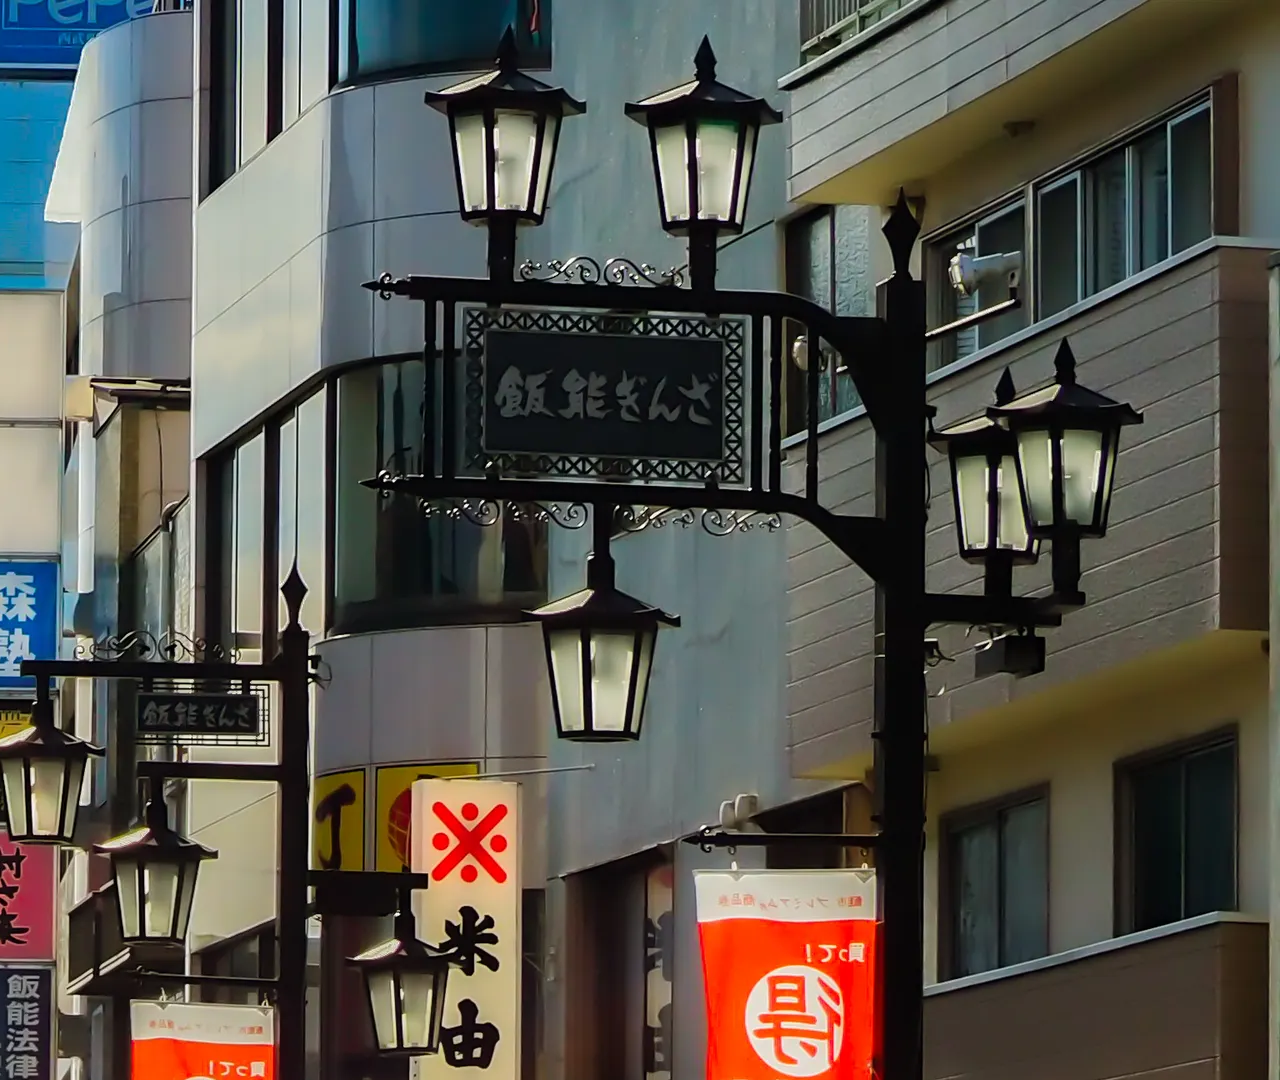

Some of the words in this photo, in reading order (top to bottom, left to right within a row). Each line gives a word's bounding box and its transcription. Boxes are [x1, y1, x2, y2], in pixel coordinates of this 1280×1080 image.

[494, 364, 720, 427] 飯能ぎんざ
